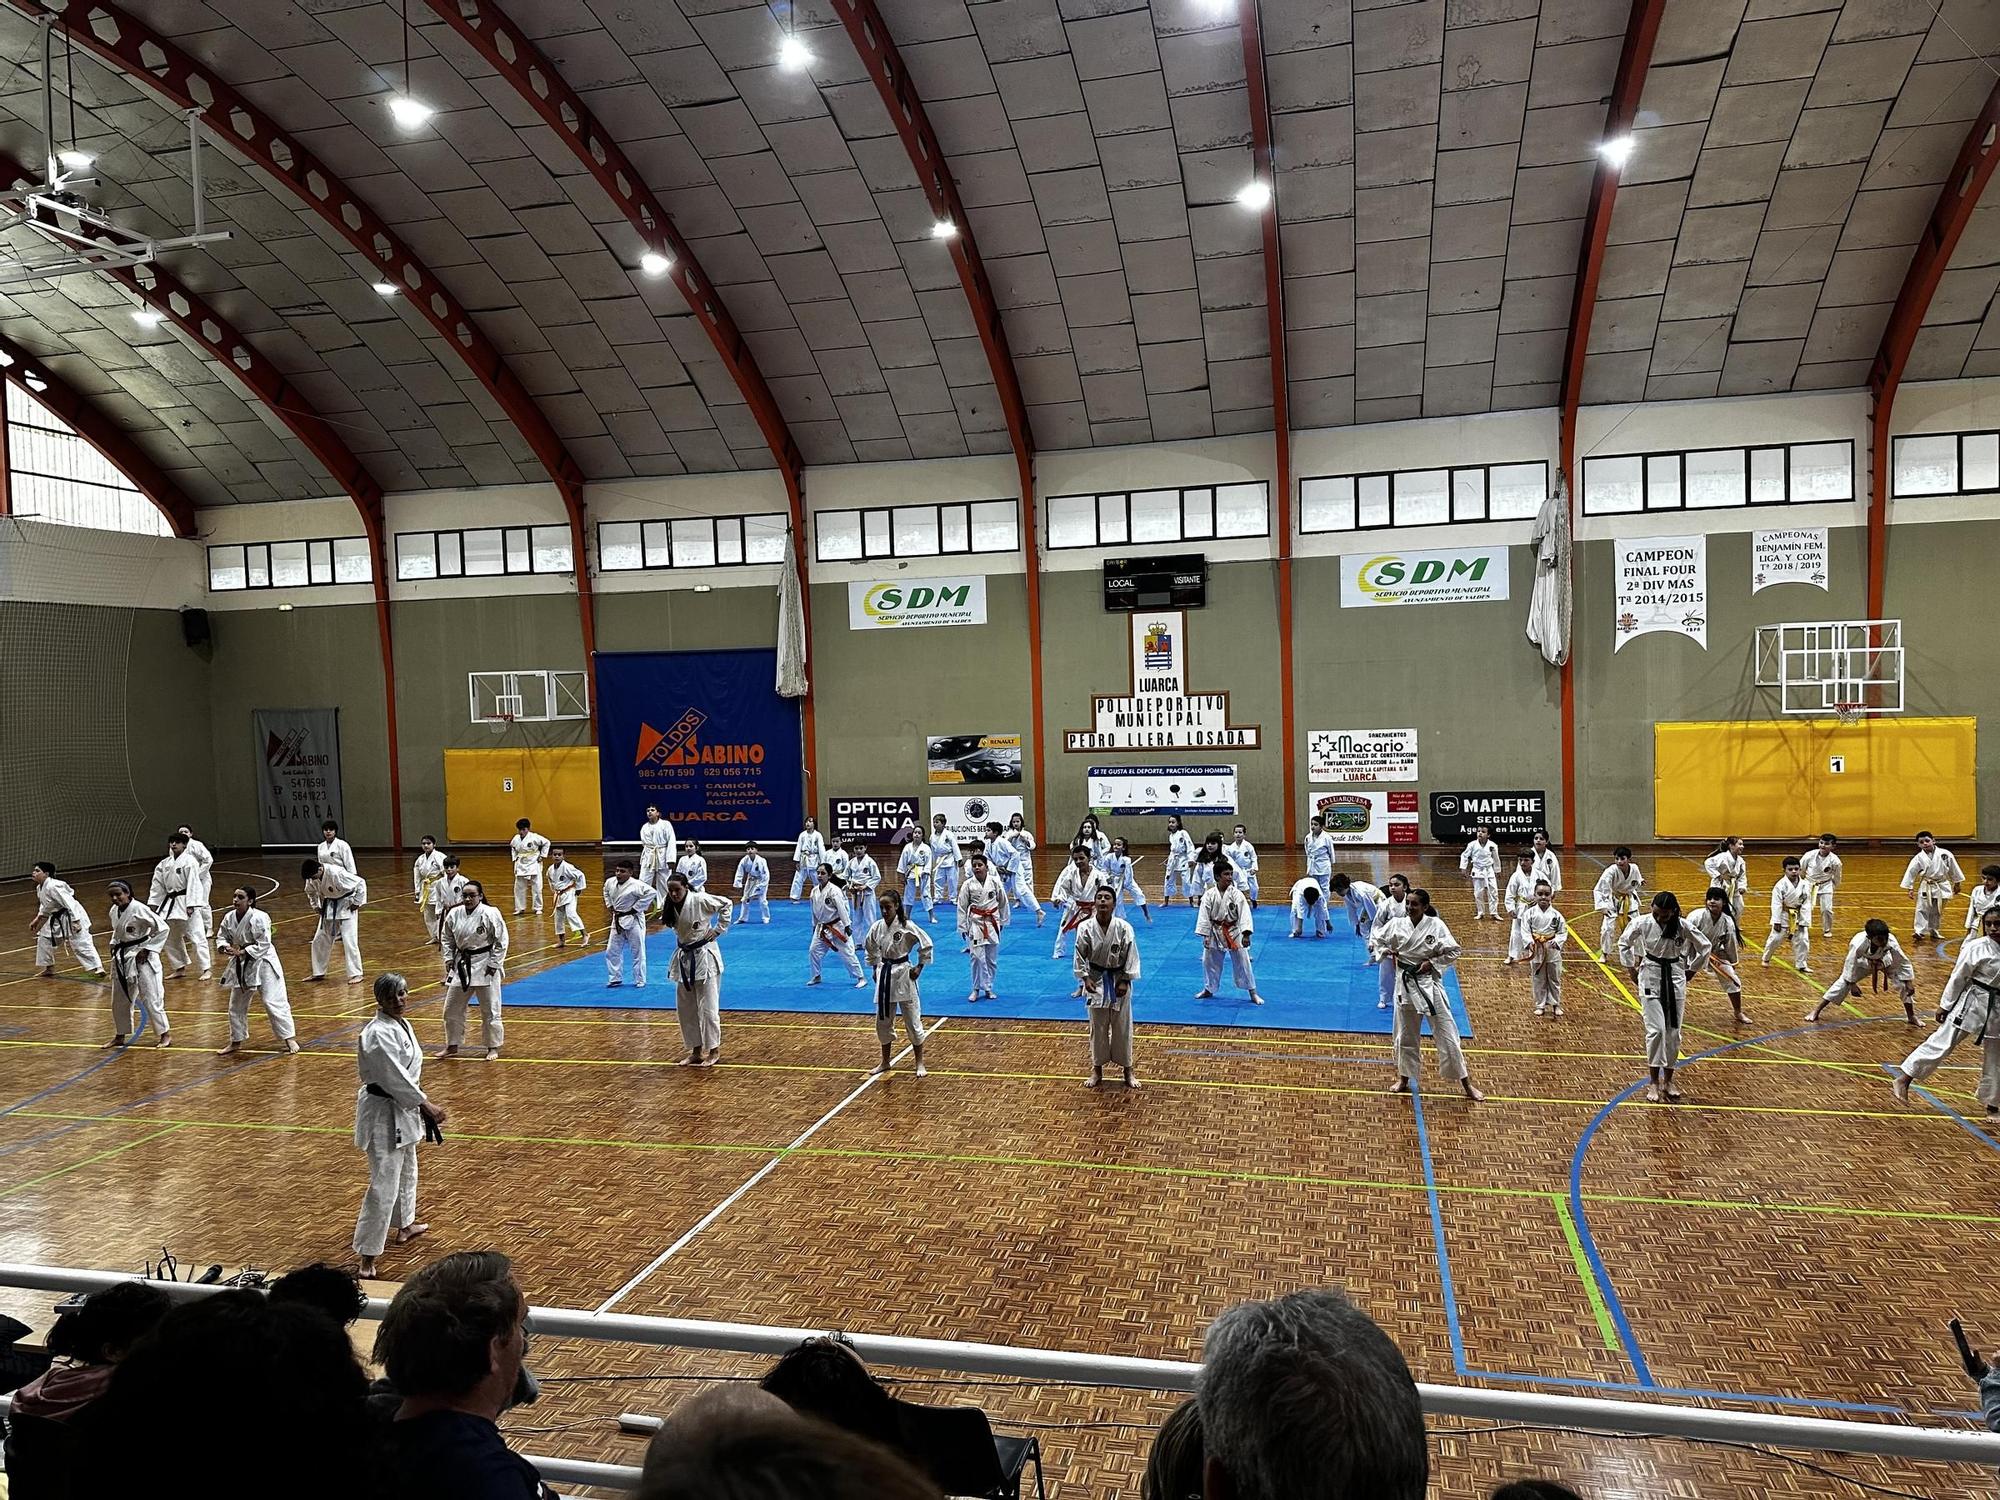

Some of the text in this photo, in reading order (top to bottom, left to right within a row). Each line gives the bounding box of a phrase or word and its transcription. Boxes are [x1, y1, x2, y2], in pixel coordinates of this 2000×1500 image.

[1762, 531, 1818, 542] CAMPEONAS
[1756, 542, 1825, 553] BENJAMÍN FEM.
[1626, 549, 1694, 562] CAMPEON
[1797, 553, 1821, 561] COPA
[1374, 557, 1490, 586] SDM
[1624, 565, 1696, 577] FINAL FOUR
[1108, 576, 1200, 588] LOCAL VISITANTE
[1627, 579, 1694, 591] 2ª DIV MAS
[1452, 586, 1491, 594] MUNICIPAL
[877, 585, 971, 610] SDM
[1635, 593, 1704, 606] 2014/2015
[1139, 677, 1179, 692] LUARCA
[1098, 696, 1223, 713] POLIDEPORTIVO
[1116, 712, 1202, 727] MUNICIPAL
[647, 713, 700, 763] TOLDOS
[1069, 731, 1245, 748] PEDRO LLERA LOSADA
[1338, 735, 1404, 753] Macario
[686, 734, 765, 765] SABINO
[1832, 760, 1840, 771] 1
[638, 767, 761, 777] 985 470 590 629 056 715
[1343, 773, 1377, 781] LUARCA
[505, 782, 511, 791] 3
[837, 802, 913, 814] OPTICA
[1320, 798, 1329, 806] LA
[1463, 798, 1542, 813] MAPFRE
[268, 804, 333, 819] LUARCA
[669, 811, 748, 822] UARCA
[837, 817, 915, 829] ELENA
[1477, 816, 1533, 824] SEGUROS
[1347, 834, 1363, 842] 1896
